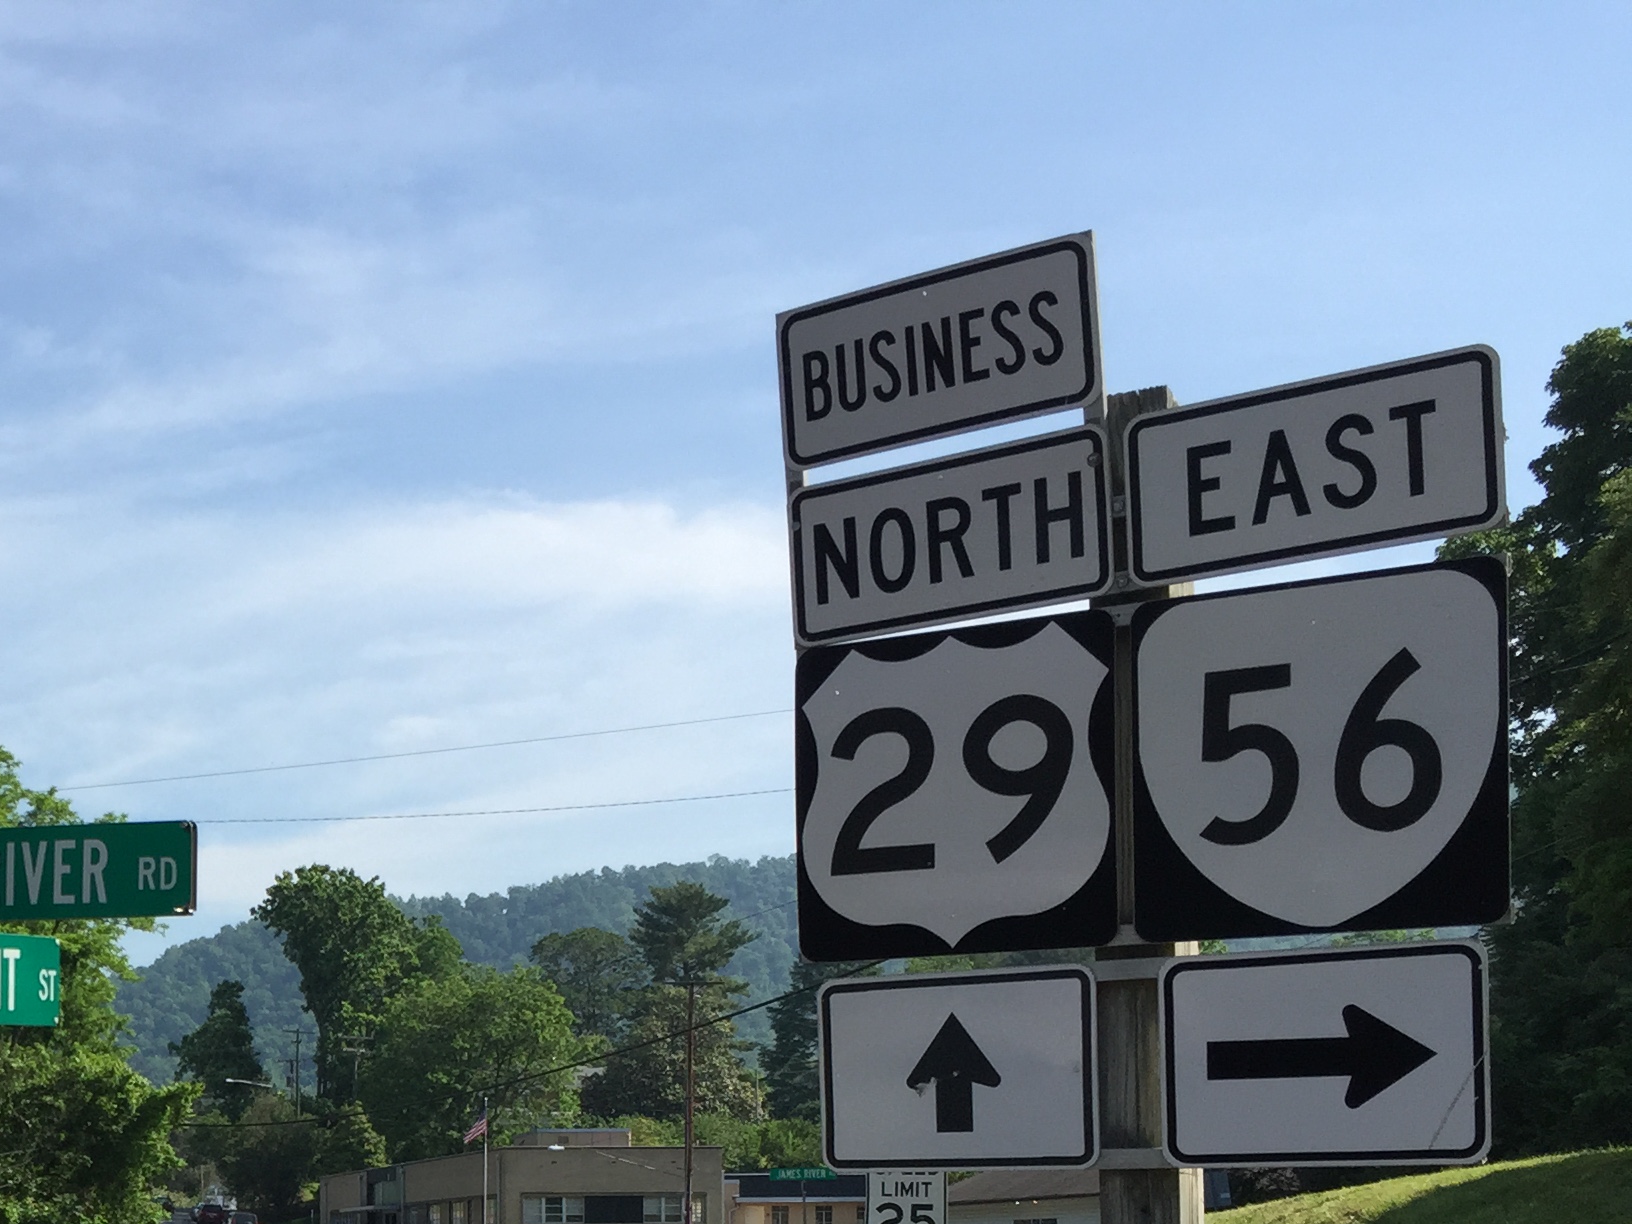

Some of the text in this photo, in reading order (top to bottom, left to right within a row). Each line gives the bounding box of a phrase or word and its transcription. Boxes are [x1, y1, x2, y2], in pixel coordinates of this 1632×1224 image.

[803, 290, 1064, 423] BUSINESS
[1186, 400, 1437, 537] EAST
[813, 470, 1085, 605] NORTH
[830, 693, 1074, 877] 29
[1198, 646, 1443, 846] 56
[137, 856, 178, 891] RD
[38, 968, 57, 1002] ST
[777, 1168, 802, 1180] JAMES
[803, 1168, 826, 1179] RIVER
[881, 1181, 932, 1197] LIMIT
